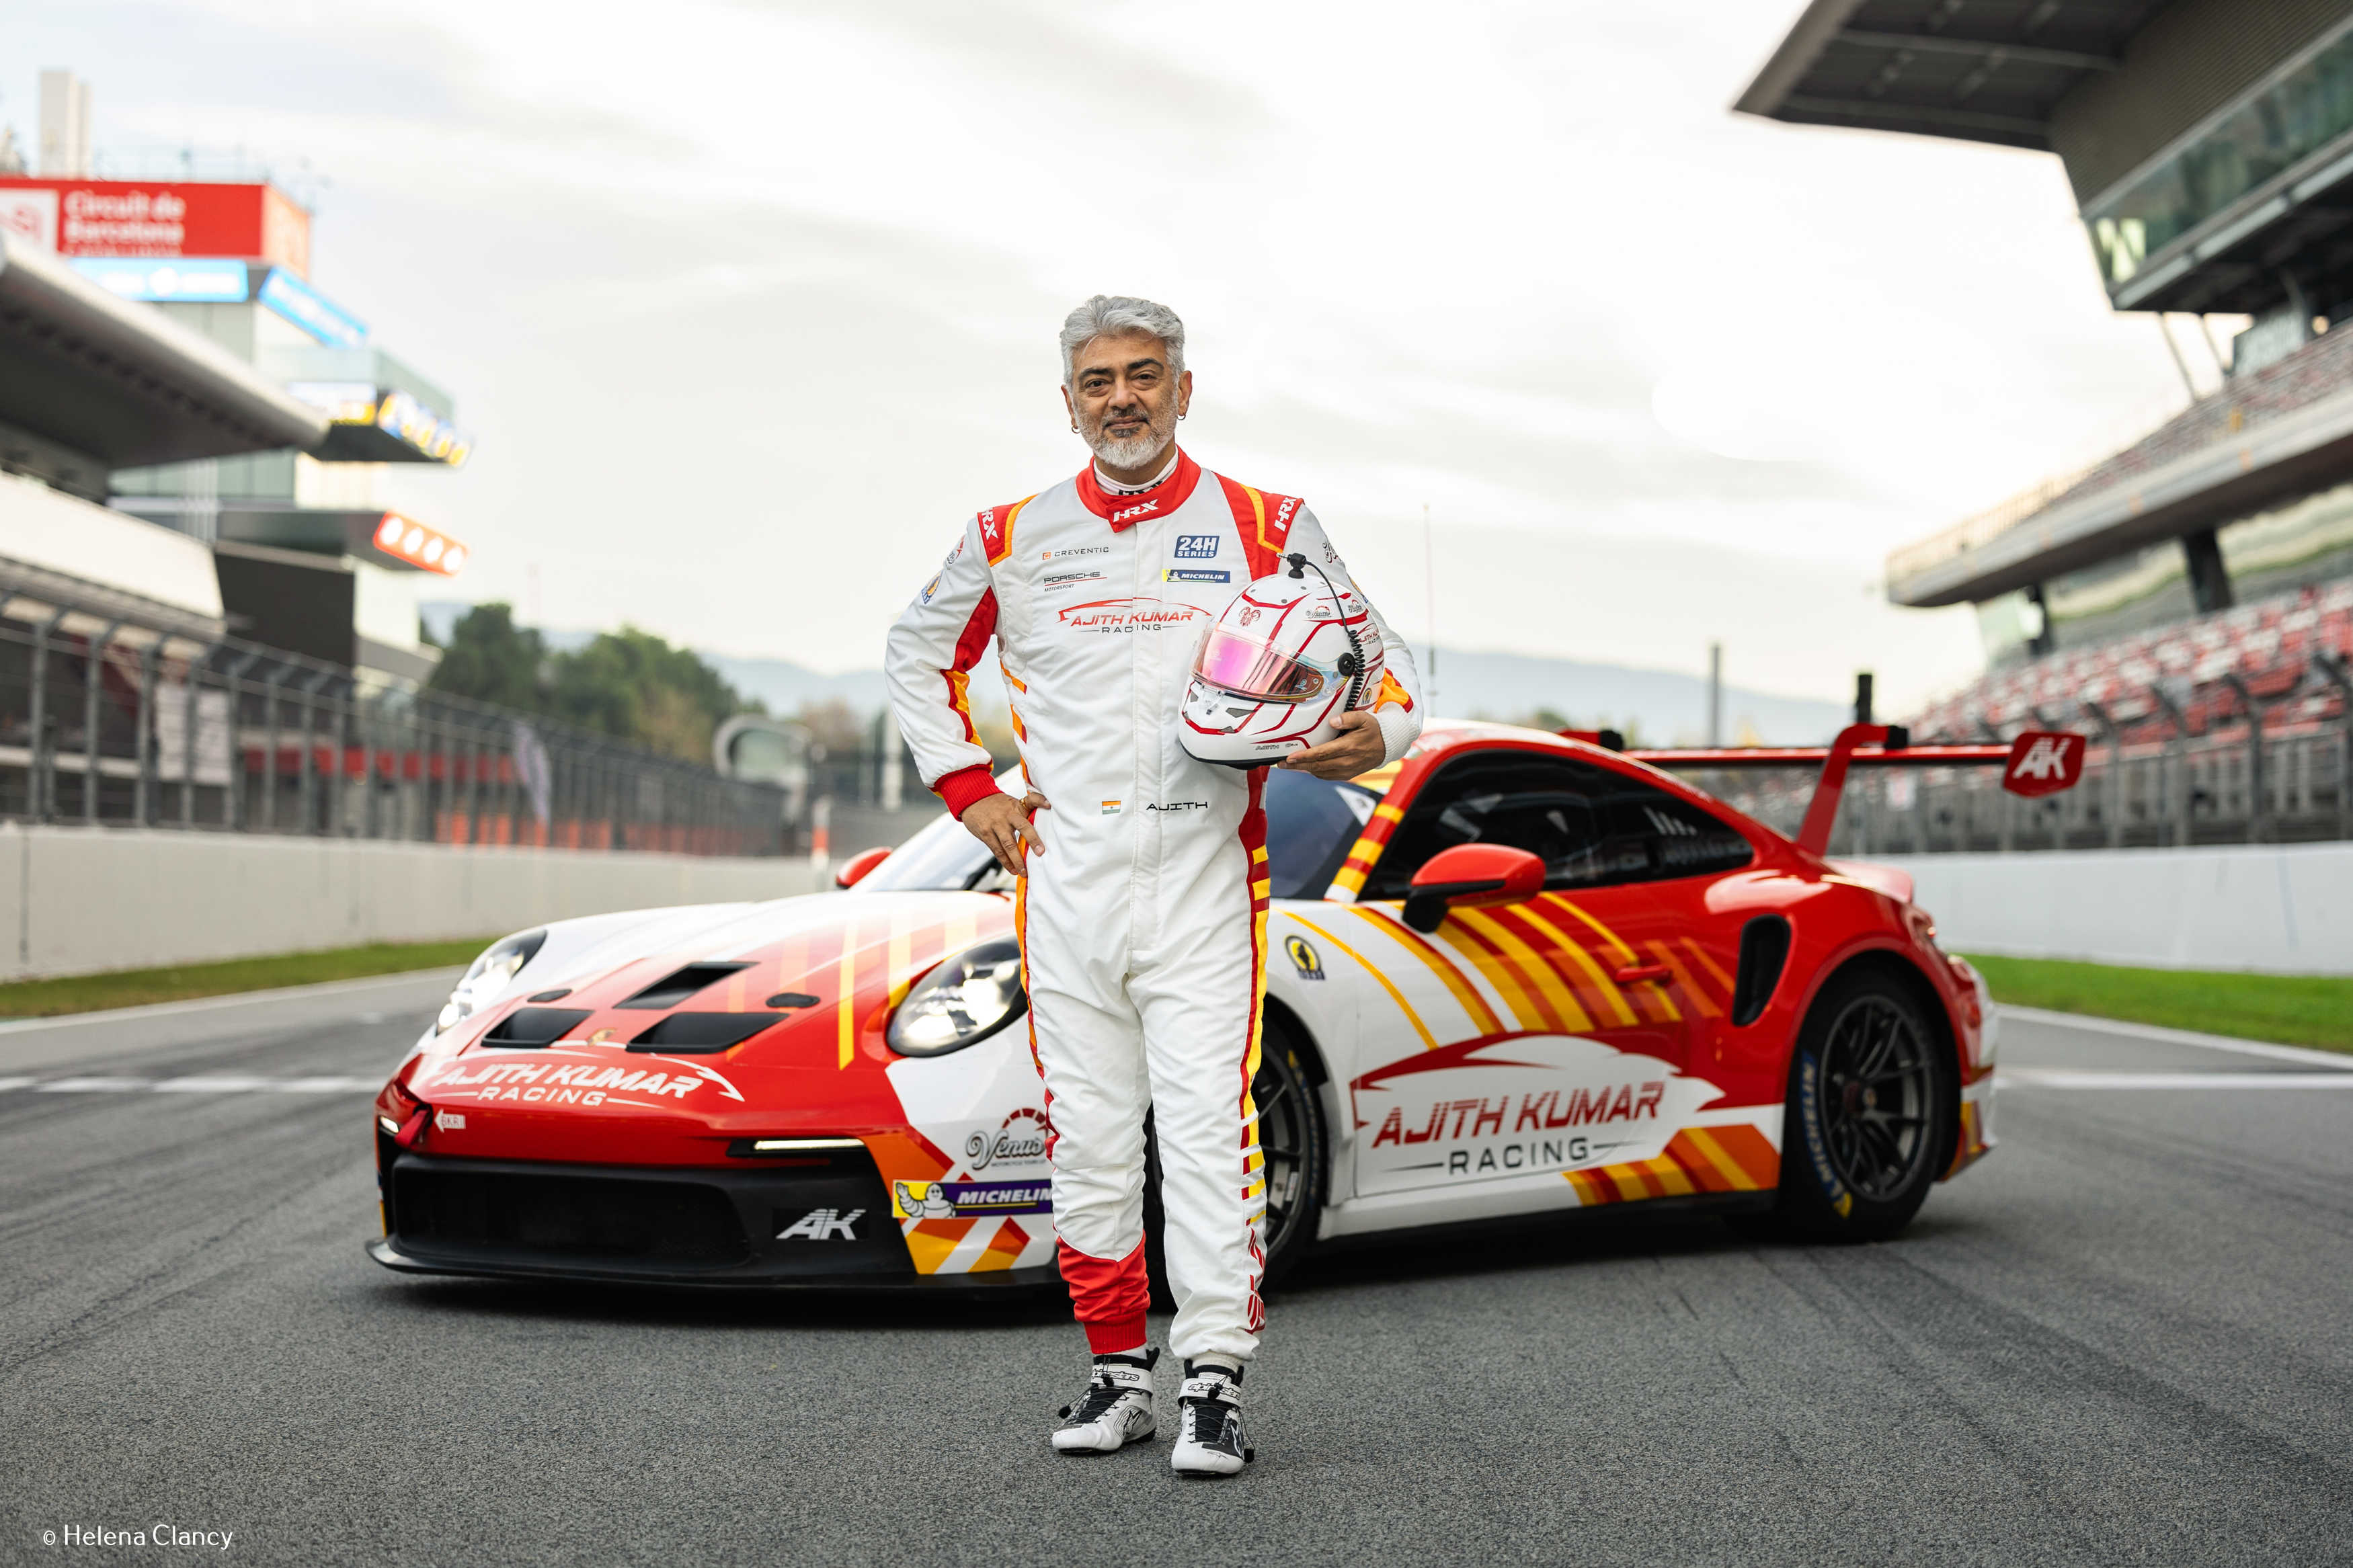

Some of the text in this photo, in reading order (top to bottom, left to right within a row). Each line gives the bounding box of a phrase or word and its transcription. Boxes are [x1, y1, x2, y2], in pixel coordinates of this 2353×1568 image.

[1113, 499, 1159, 522] HRX
[1274, 497, 1297, 532] HRX
[1054, 546, 1110, 557] CREVENTIC
[1178, 536, 1218, 551] 24H
[1043, 571, 1101, 584] PORSCHE
[1044, 583, 1075, 592] MOTORSPORT
[1070, 611, 1195, 627] AJITH KUMAR
[1102, 624, 1162, 634] RACING
[2011, 736, 2072, 780] AK
[1146, 801, 1209, 811] AJITH
[433, 1063, 704, 1099] AJITH KUMAR
[477, 1086, 608, 1106] RACING
[1371, 1094, 1510, 1149] AJITH
[1514, 1081, 1665, 1133] KUMAR
[966, 1130, 1046, 1170] Venus
[1448, 1137, 1590, 1175] RACING
[957, 1188, 1052, 1204] MICHELIN
[775, 1208, 867, 1240] AK
